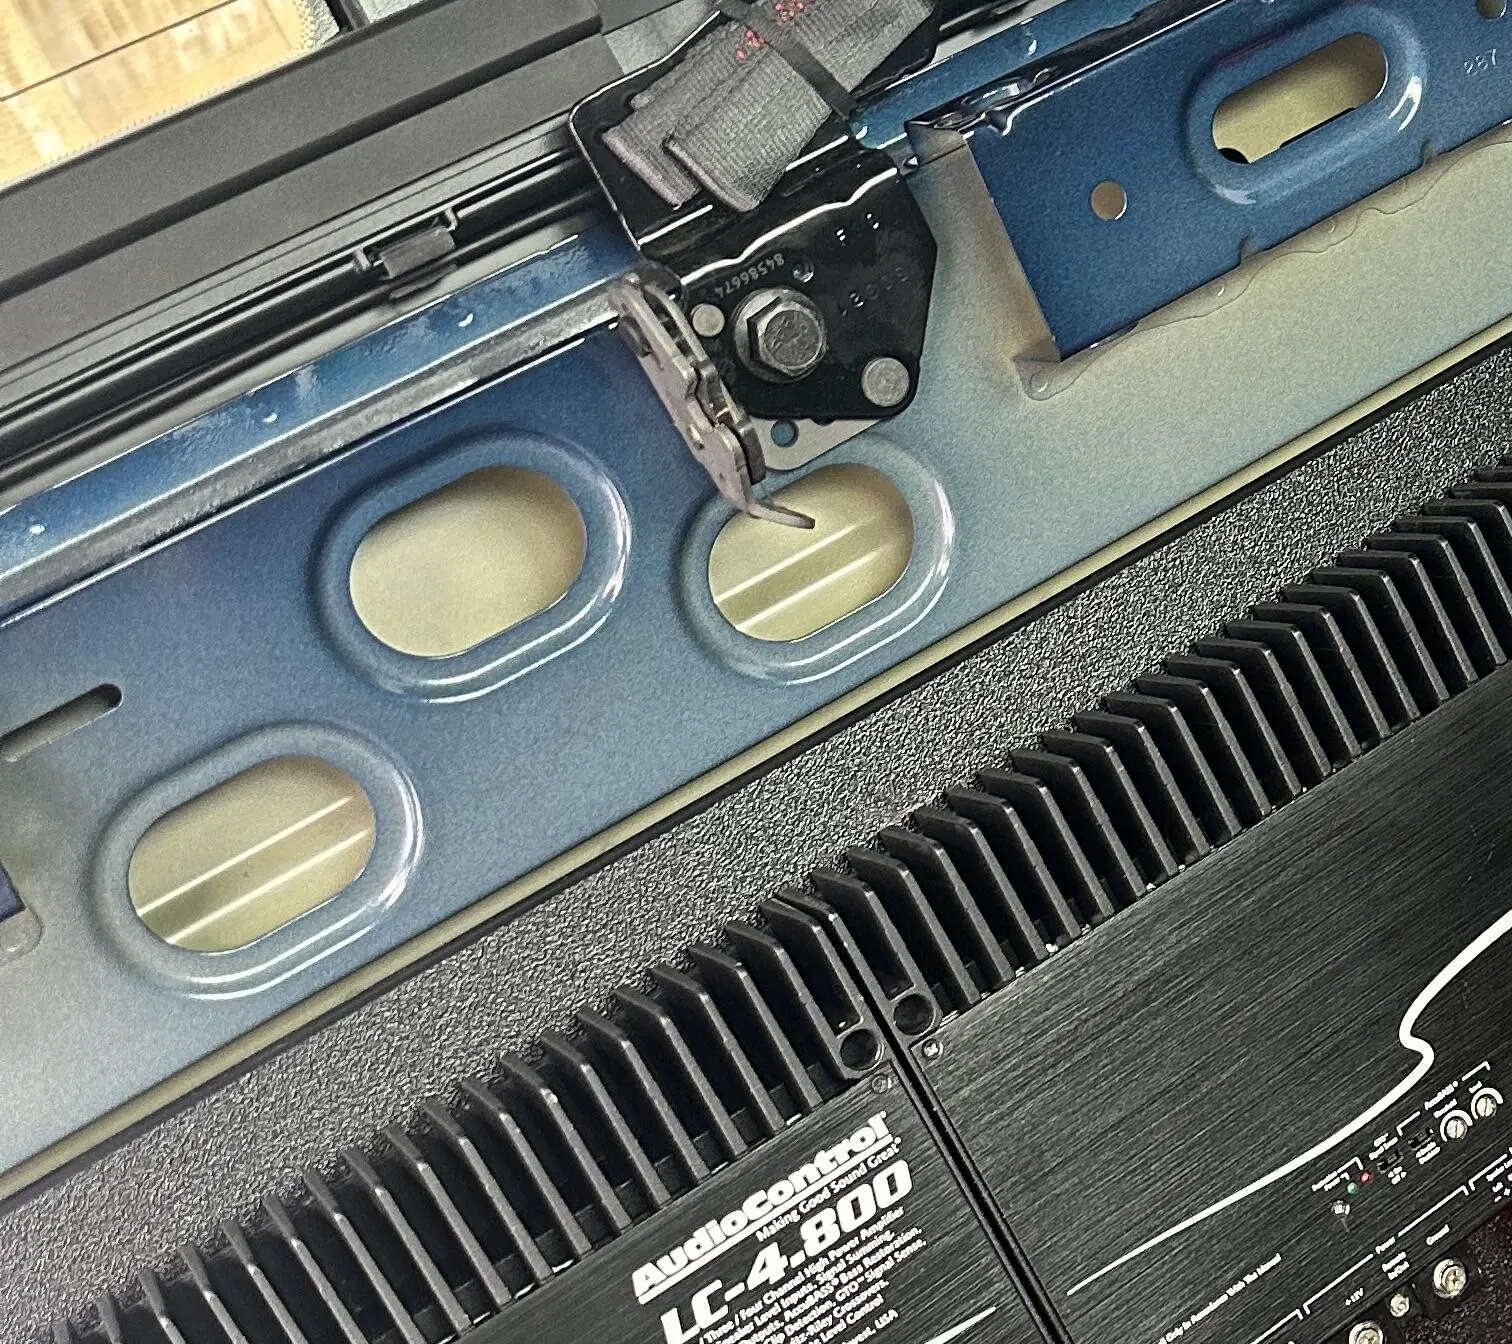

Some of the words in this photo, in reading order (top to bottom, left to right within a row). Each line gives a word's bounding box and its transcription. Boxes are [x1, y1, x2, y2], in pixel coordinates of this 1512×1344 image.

[714, 253, 785, 298] 84586674
[755, 1207, 800, 1242] Making
[797, 1185, 831, 1213] Good
[828, 1161, 867, 1193] Sound
[703, 1320, 734, 1343] Three
[738, 1300, 763, 1320] Four
[762, 1270, 805, 1304] Channel
[803, 1256, 829, 1277] High
[827, 1236, 859, 1261] Power
[859, 1206, 904, 1239] Amplifier
[753, 1302, 781, 1326] Level
[815, 1258, 847, 1285] Signal
[838, 1263, 863, 1284] Bass
[863, 1256, 895, 1282] Signal
[819, 1318, 847, 1343] Level
[845, 1293, 884, 1324] Control
[873, 1309, 898, 1329] USA
